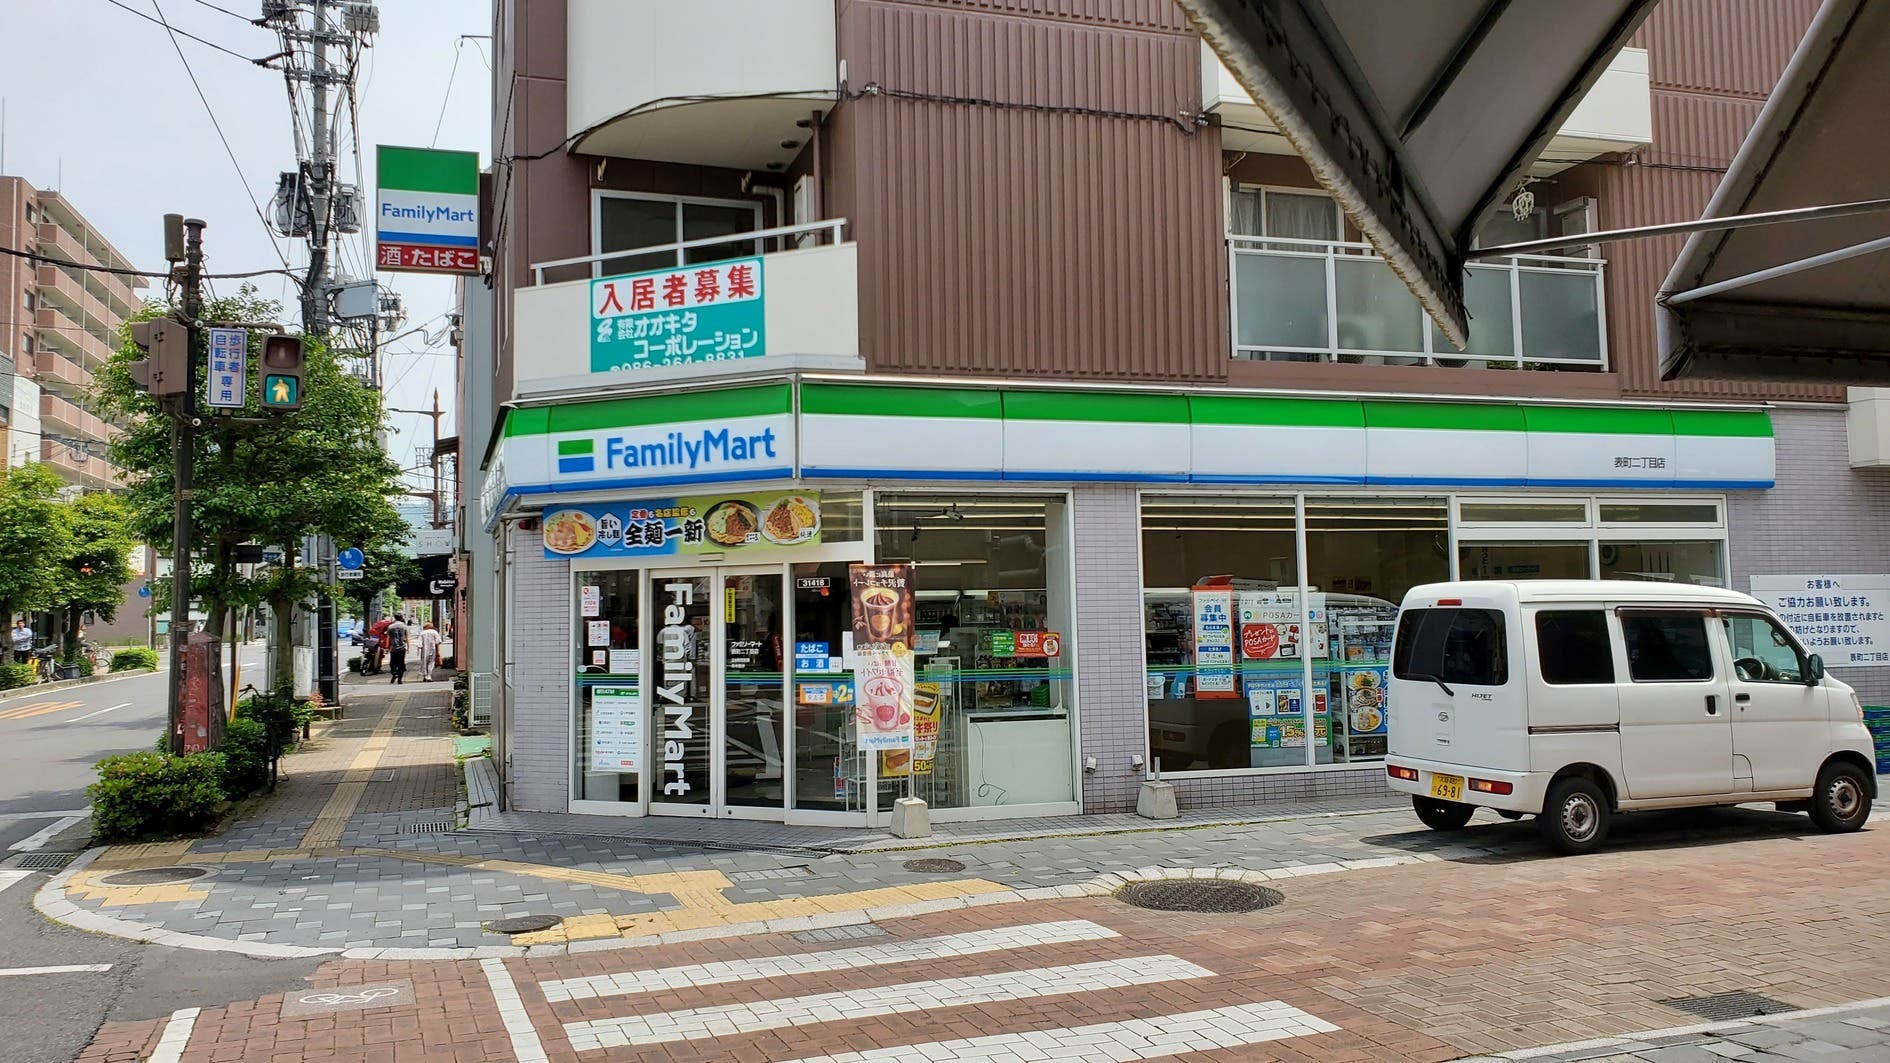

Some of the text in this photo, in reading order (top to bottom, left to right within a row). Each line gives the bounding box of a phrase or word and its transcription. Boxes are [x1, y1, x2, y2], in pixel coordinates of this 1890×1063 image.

[382, 203, 475, 223] FamilyMart
[381, 246, 475, 269] 酒・たばこ
[599, 264, 755, 315] 入居者募集
[634, 312, 698, 338] オオキタ
[633, 328, 758, 360] コーポレーション
[214, 335, 227, 372] 自転車
[229, 335, 241, 373] 歩行者
[606, 427, 777, 469] FamilyMart
[1614, 456, 1666, 469] 表町二丁目店
[624, 519, 704, 546] 全麺一新
[1807, 579, 1840, 589] お客様へ
[1204, 604, 1222, 613] 会員
[1778, 596, 1870, 608] ご協力お願い致します。
[1200, 613, 1227, 622] 募集中
[1262, 611, 1300, 619] POSAカー
[800, 644, 824, 653] たばこ
[1800, 636, 1874, 646] いようお願い致します。
[1850, 652, 1889, 662] 表町二丁目店
[657, 583, 693, 796] FamilyMart
[1437, 784, 1460, 799] 69-81
